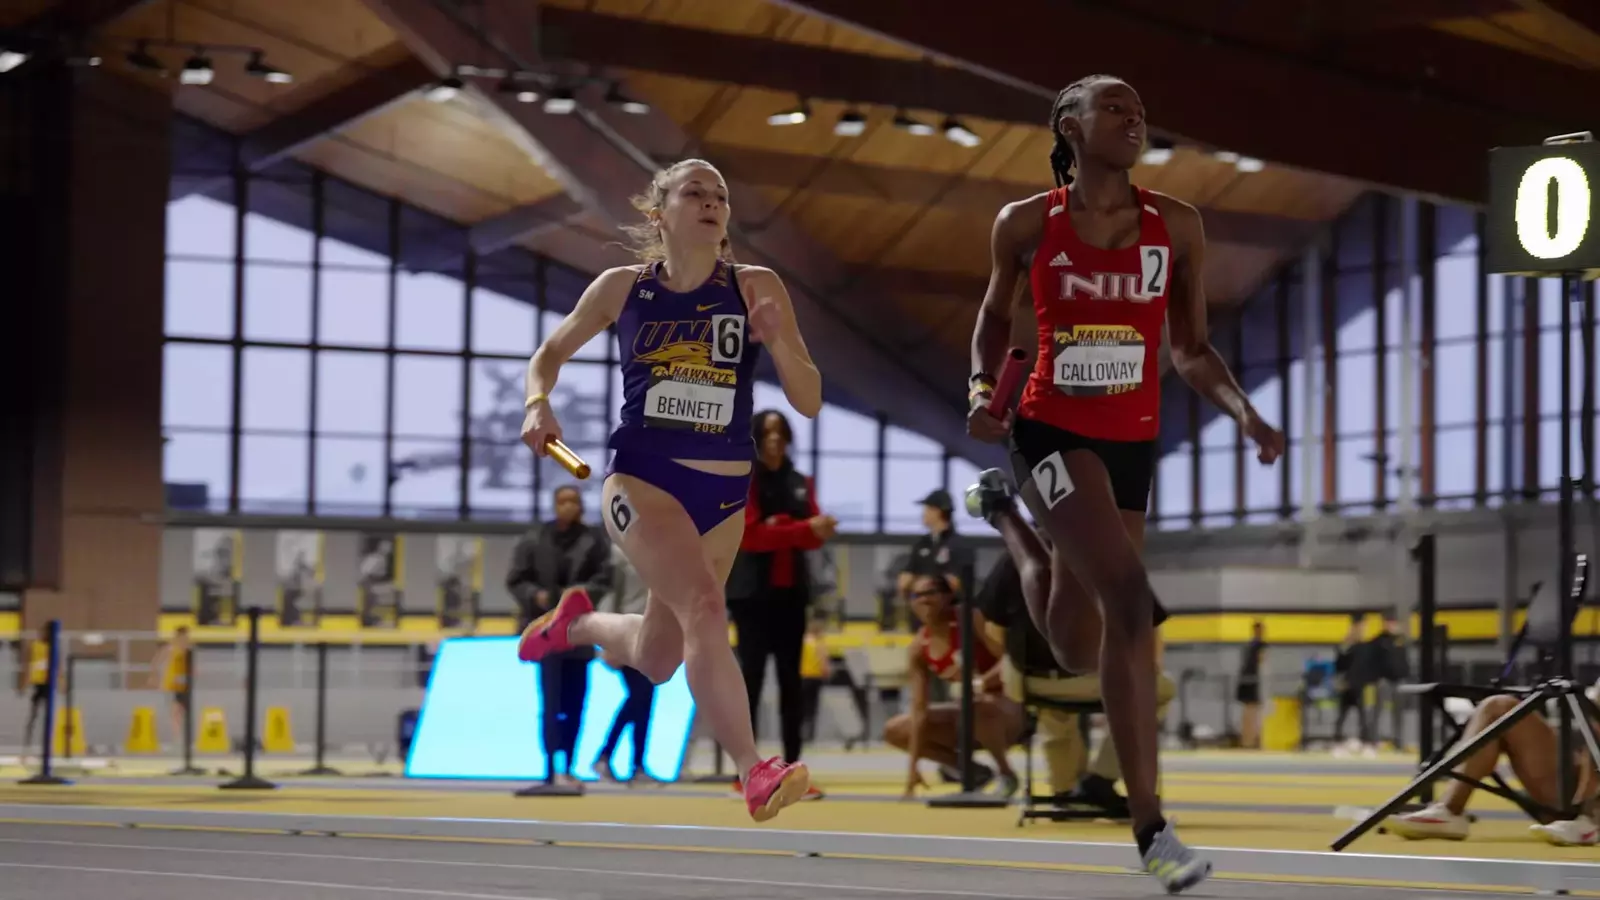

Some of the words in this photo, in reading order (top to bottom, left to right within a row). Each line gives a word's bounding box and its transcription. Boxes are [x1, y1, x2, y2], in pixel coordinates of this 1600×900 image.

[1515, 157, 1591, 259] 0
[1147, 249, 1163, 293] 2
[638, 289, 655, 300] SM
[1059, 272, 1153, 304] NIU
[718, 317, 740, 359] 6
[1076, 330, 1138, 341] HAWKEYE
[672, 366, 733, 383] HAWKEYE
[1061, 362, 1138, 382] CALLOWAY
[657, 396, 723, 421] BENNETT
[1038, 461, 1067, 504] 2
[611, 495, 631, 532] 6
